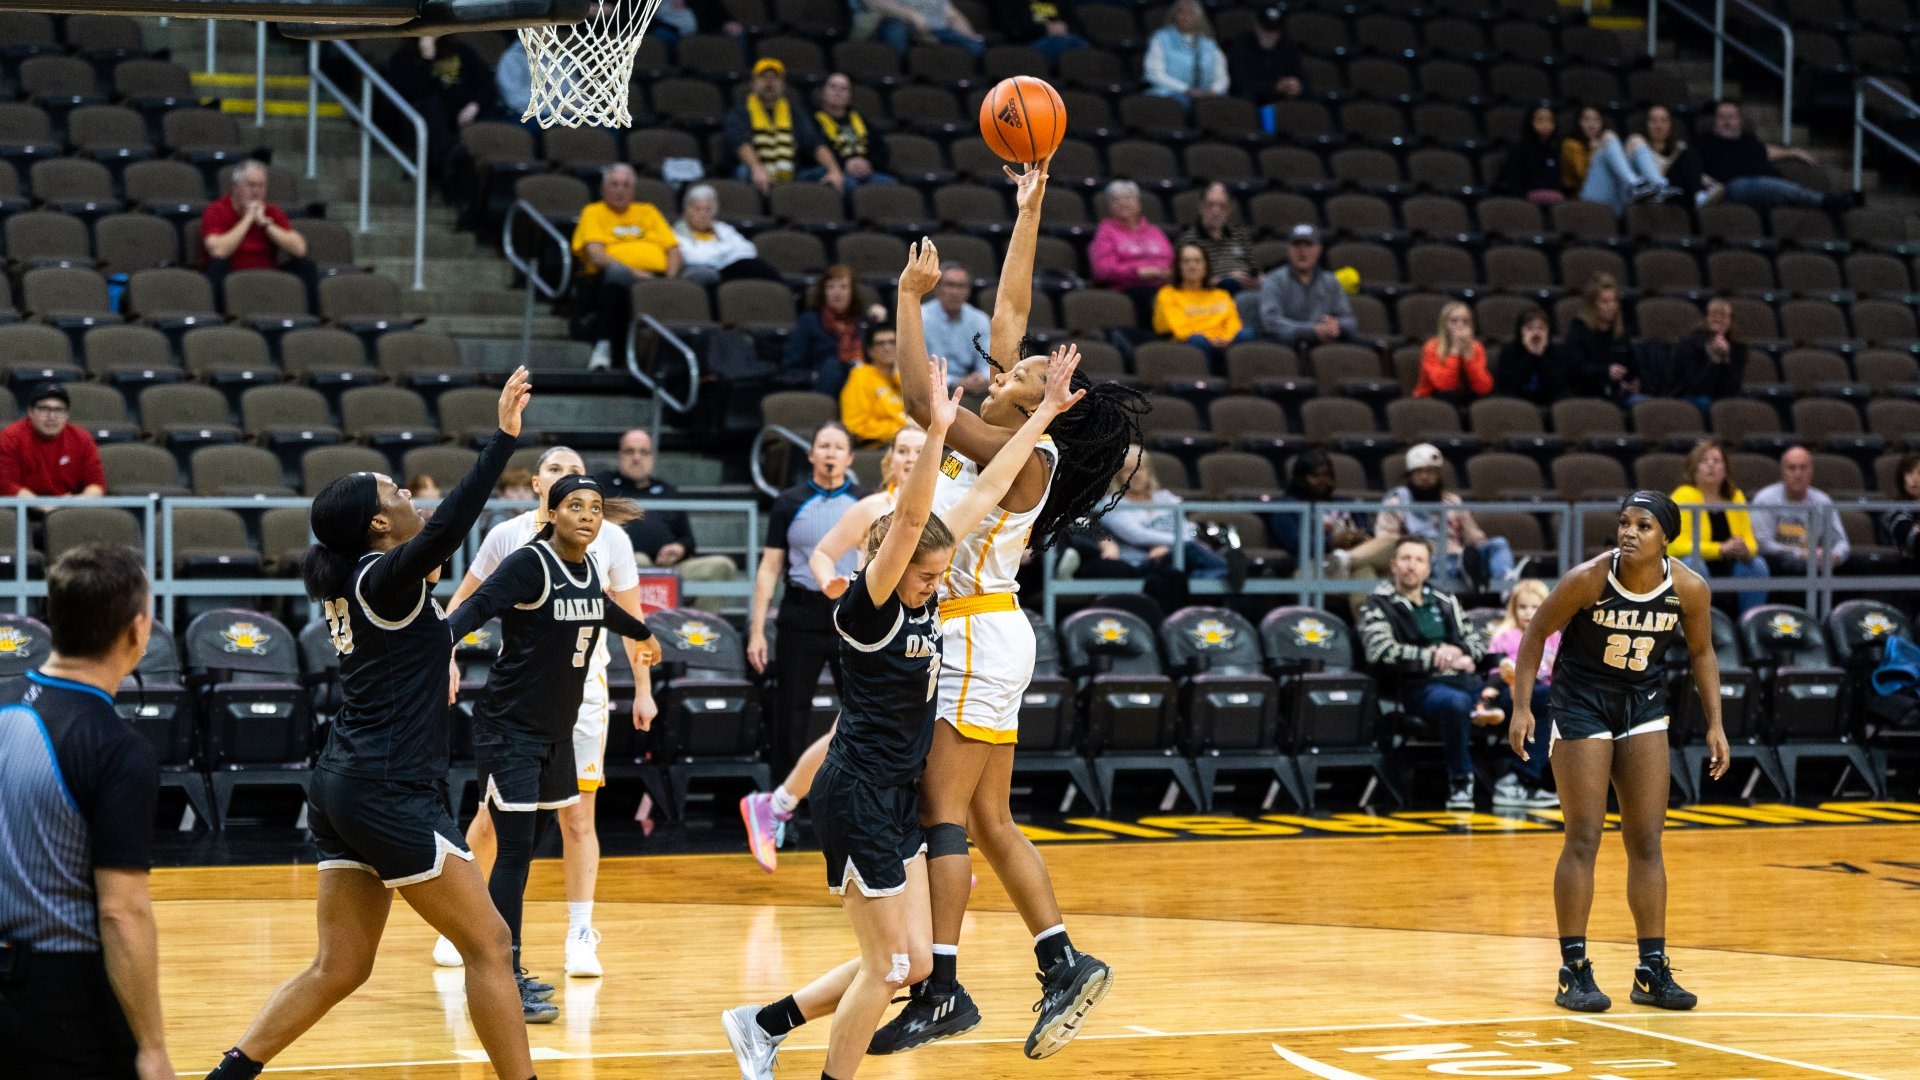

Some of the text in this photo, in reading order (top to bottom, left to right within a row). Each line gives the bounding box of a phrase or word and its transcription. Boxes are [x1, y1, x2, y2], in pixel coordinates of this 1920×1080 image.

[323, 597, 354, 656] 33
[1592, 609, 1679, 632] OAKLAND
[571, 626, 595, 668] 5
[1603, 633, 1656, 672] 23
